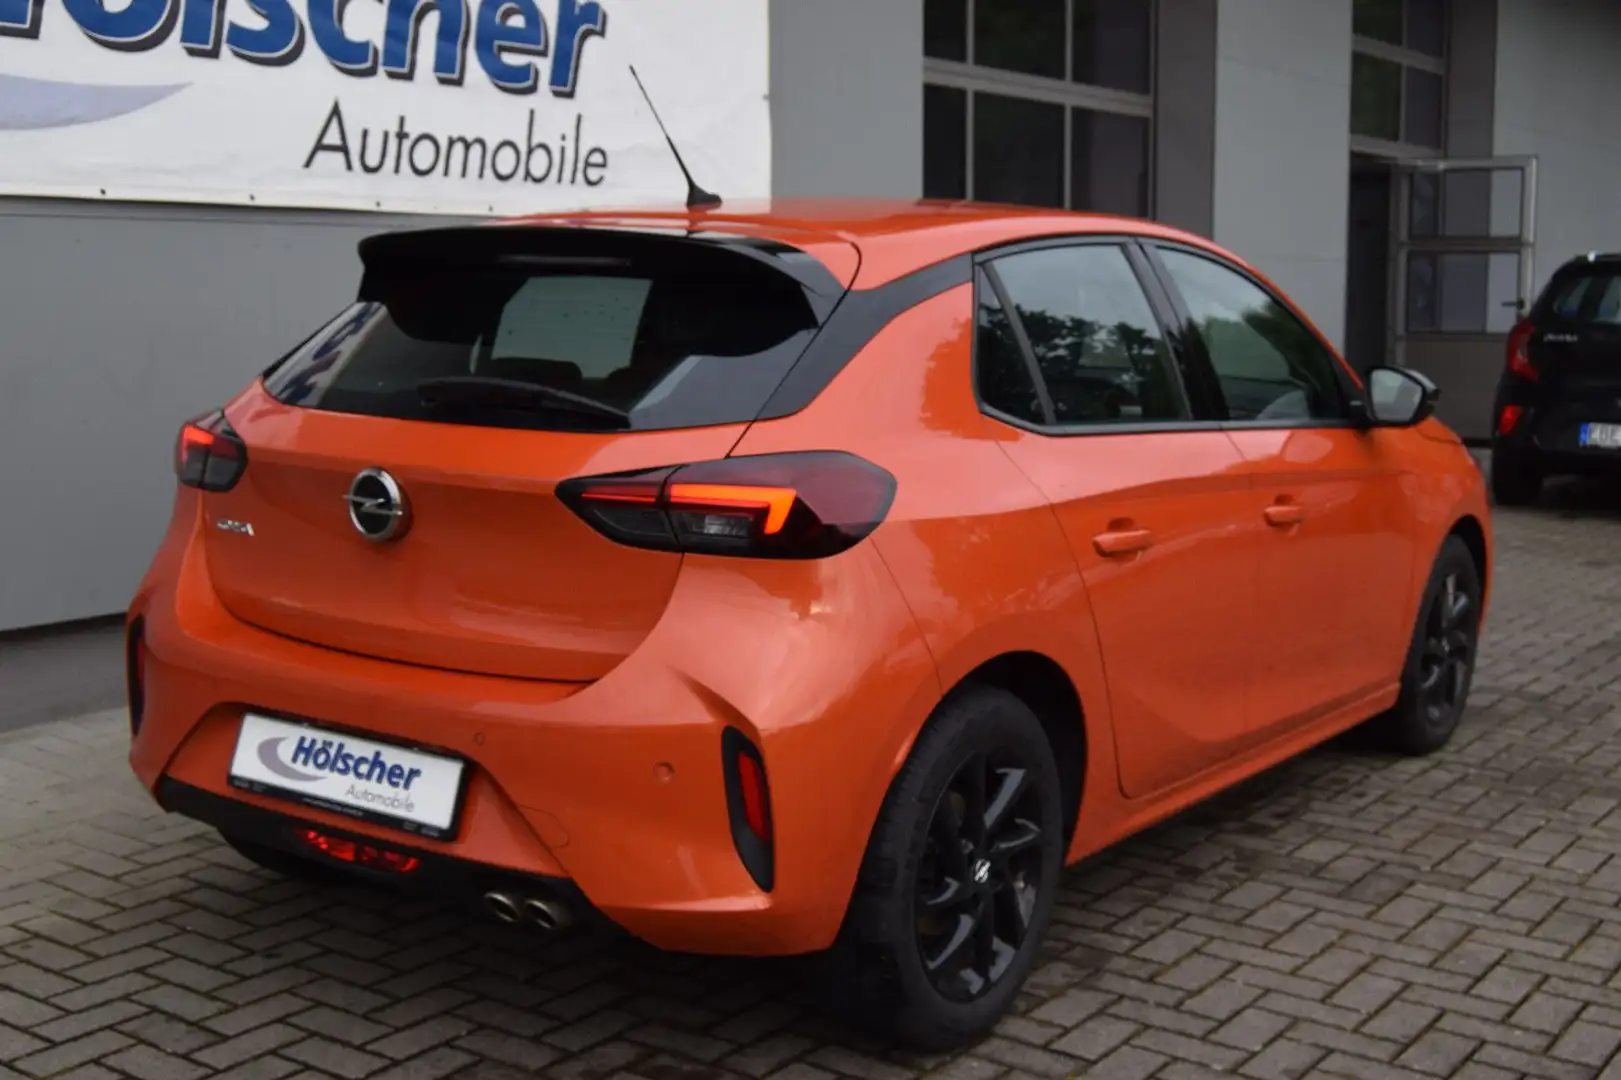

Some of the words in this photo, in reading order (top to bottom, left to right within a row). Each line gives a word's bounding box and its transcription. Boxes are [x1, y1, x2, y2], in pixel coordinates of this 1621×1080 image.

[304, 99, 609, 187] Automobile
[290, 735, 422, 790] Hölscher
[345, 784, 416, 813] Automobile
